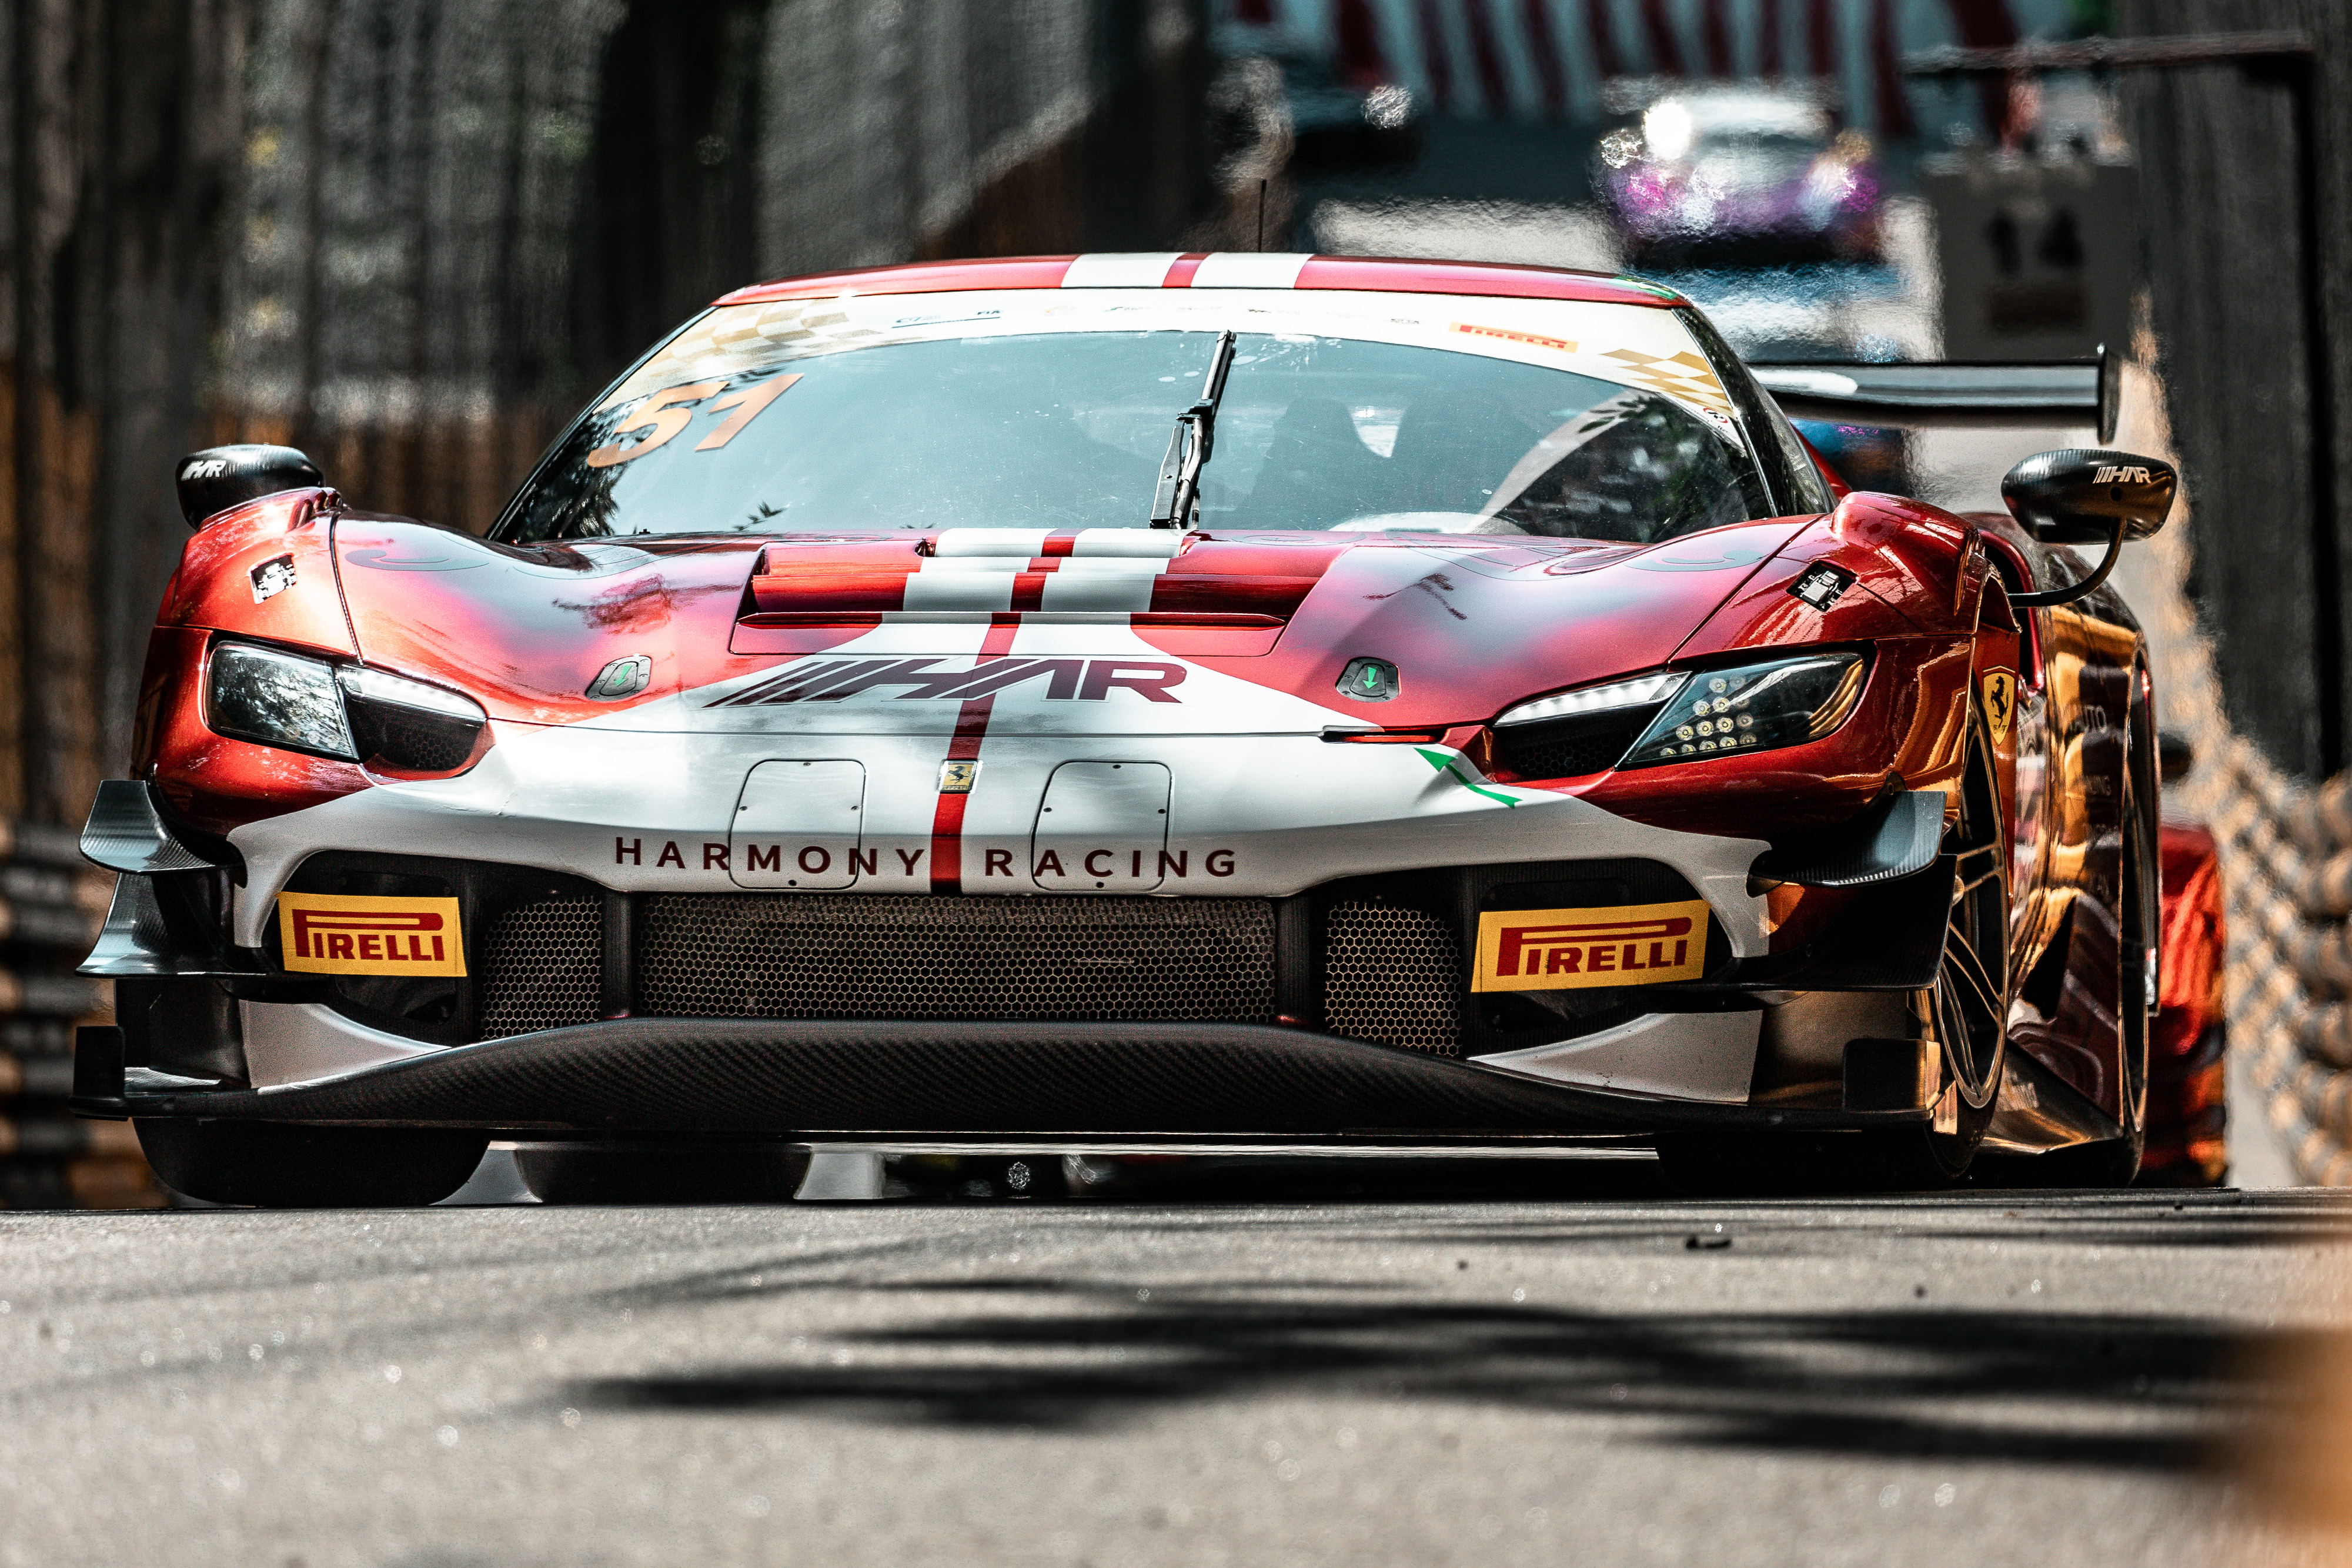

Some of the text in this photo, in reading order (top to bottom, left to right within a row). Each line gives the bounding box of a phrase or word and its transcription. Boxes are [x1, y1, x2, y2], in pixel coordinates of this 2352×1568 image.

[1459, 325, 1568, 349] PIRELLI
[587, 373, 804, 468] 51
[615, 837, 1235, 878] HARMONY RACING
[292, 908, 445, 973] PIRELLI
[1496, 917, 1692, 977] PIRELLI
